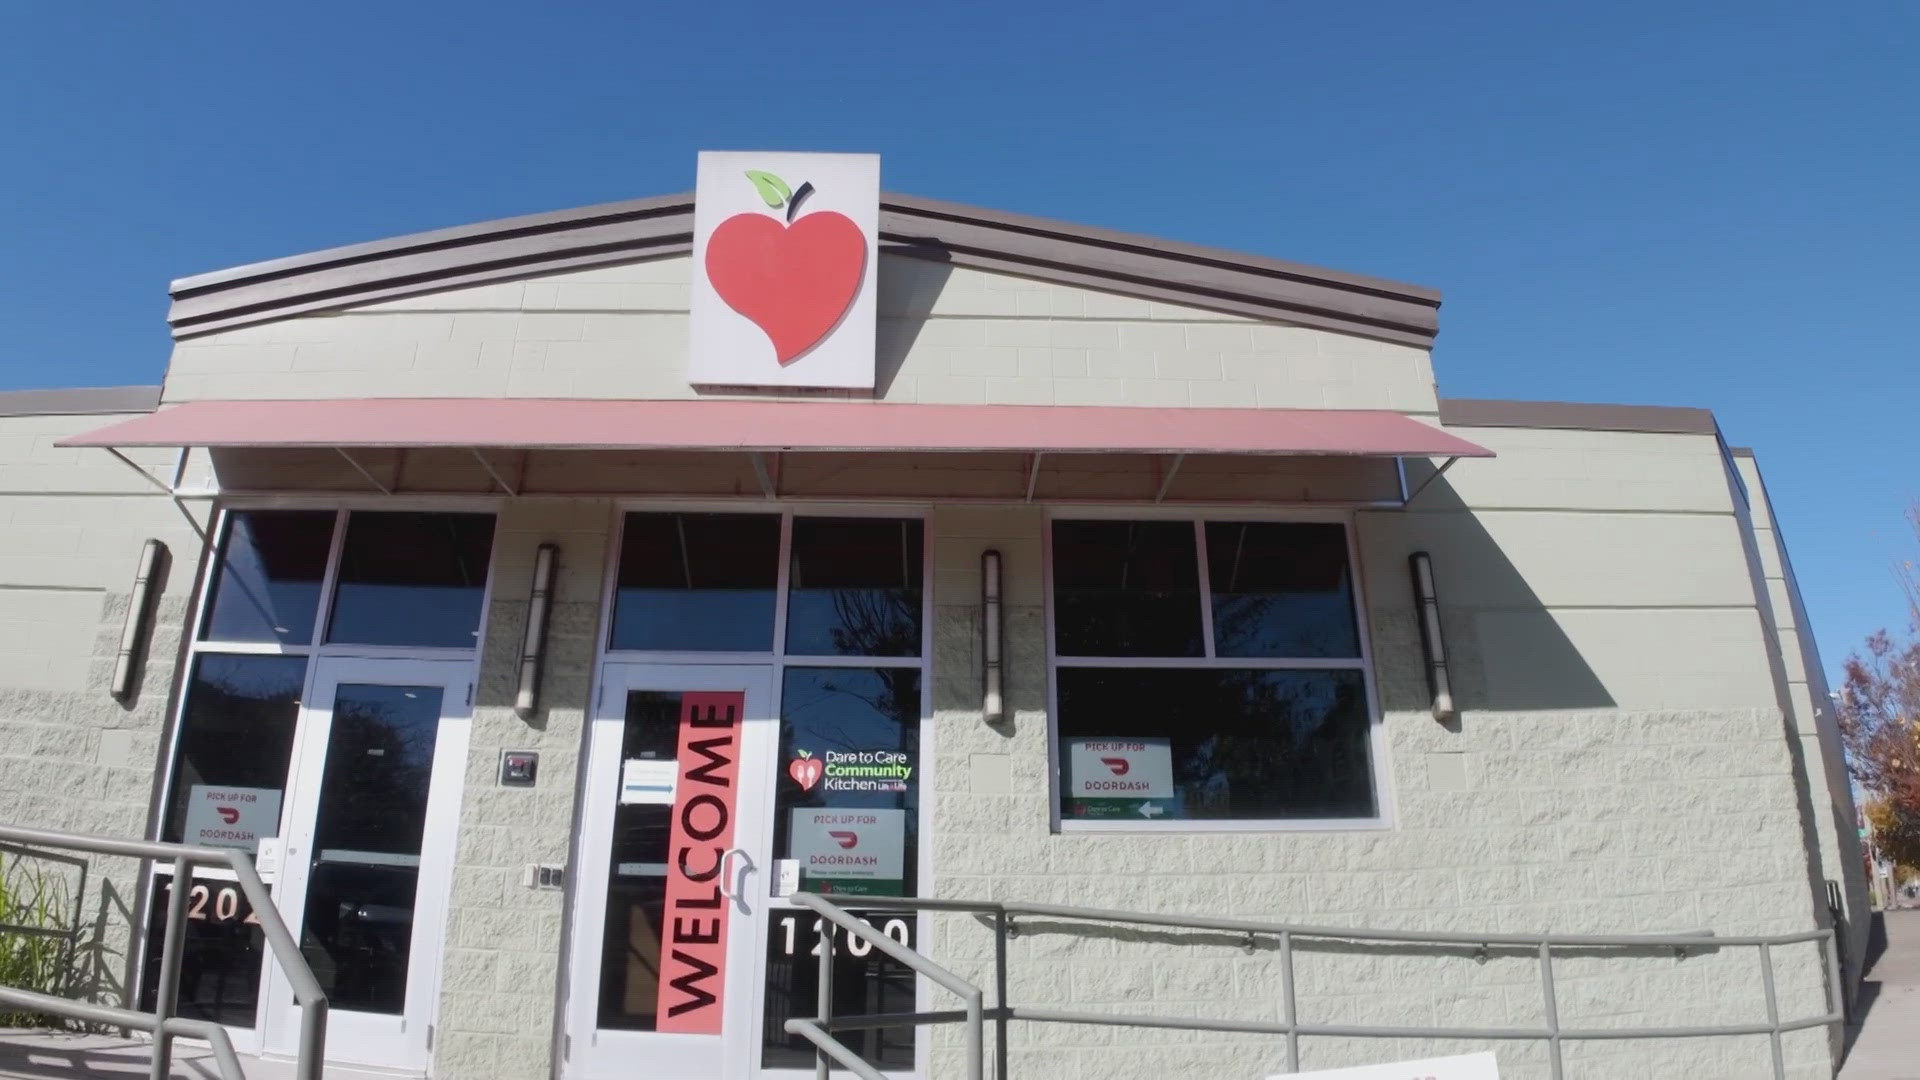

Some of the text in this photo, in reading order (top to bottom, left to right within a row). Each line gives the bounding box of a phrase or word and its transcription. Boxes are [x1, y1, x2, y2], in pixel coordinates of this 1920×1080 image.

[1085, 743, 1146, 752] PICK UP FOR
[825, 751, 907, 764] Dare to Care
[824, 763, 912, 779] Community
[824, 778, 877, 791] Kitchen
[1085, 781, 1150, 790] DOORDASH
[206, 791, 257, 803] PICK UP FOR
[814, 815, 877, 825] PICK UP FOR
[199, 829, 254, 841] DOORDASH
[668, 704, 735, 1018] WELCOME
[810, 855, 878, 866] DOORDASH
[164, 882, 261, 924] 20
